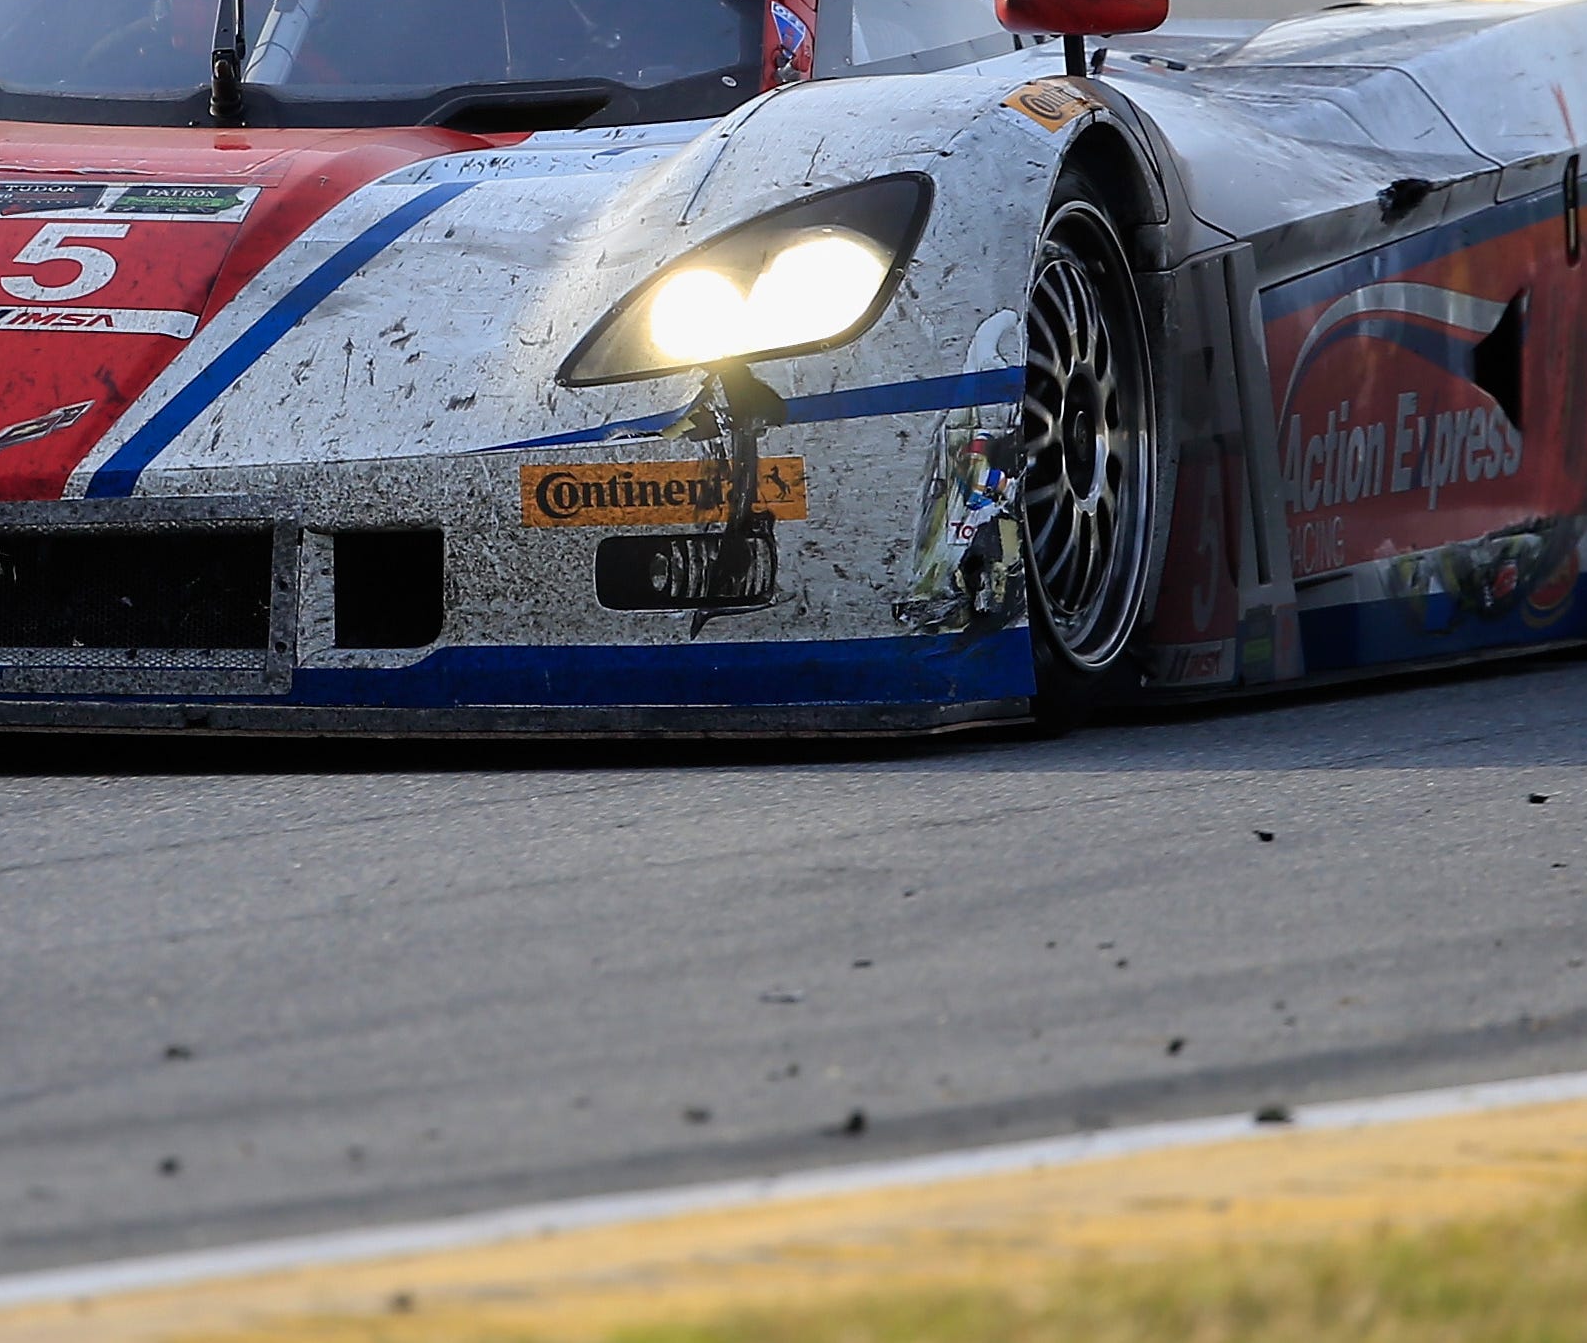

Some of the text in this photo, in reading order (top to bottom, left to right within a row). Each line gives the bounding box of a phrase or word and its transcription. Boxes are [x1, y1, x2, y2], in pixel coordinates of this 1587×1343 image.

[5, 184, 78, 193] TUDOR
[0, 221, 132, 302] 5
[7, 311, 115, 328] IMSA
[1283, 391, 1523, 514] Action Express
[535, 470, 761, 520] Continent
[1288, 515, 1346, 575] ACING
